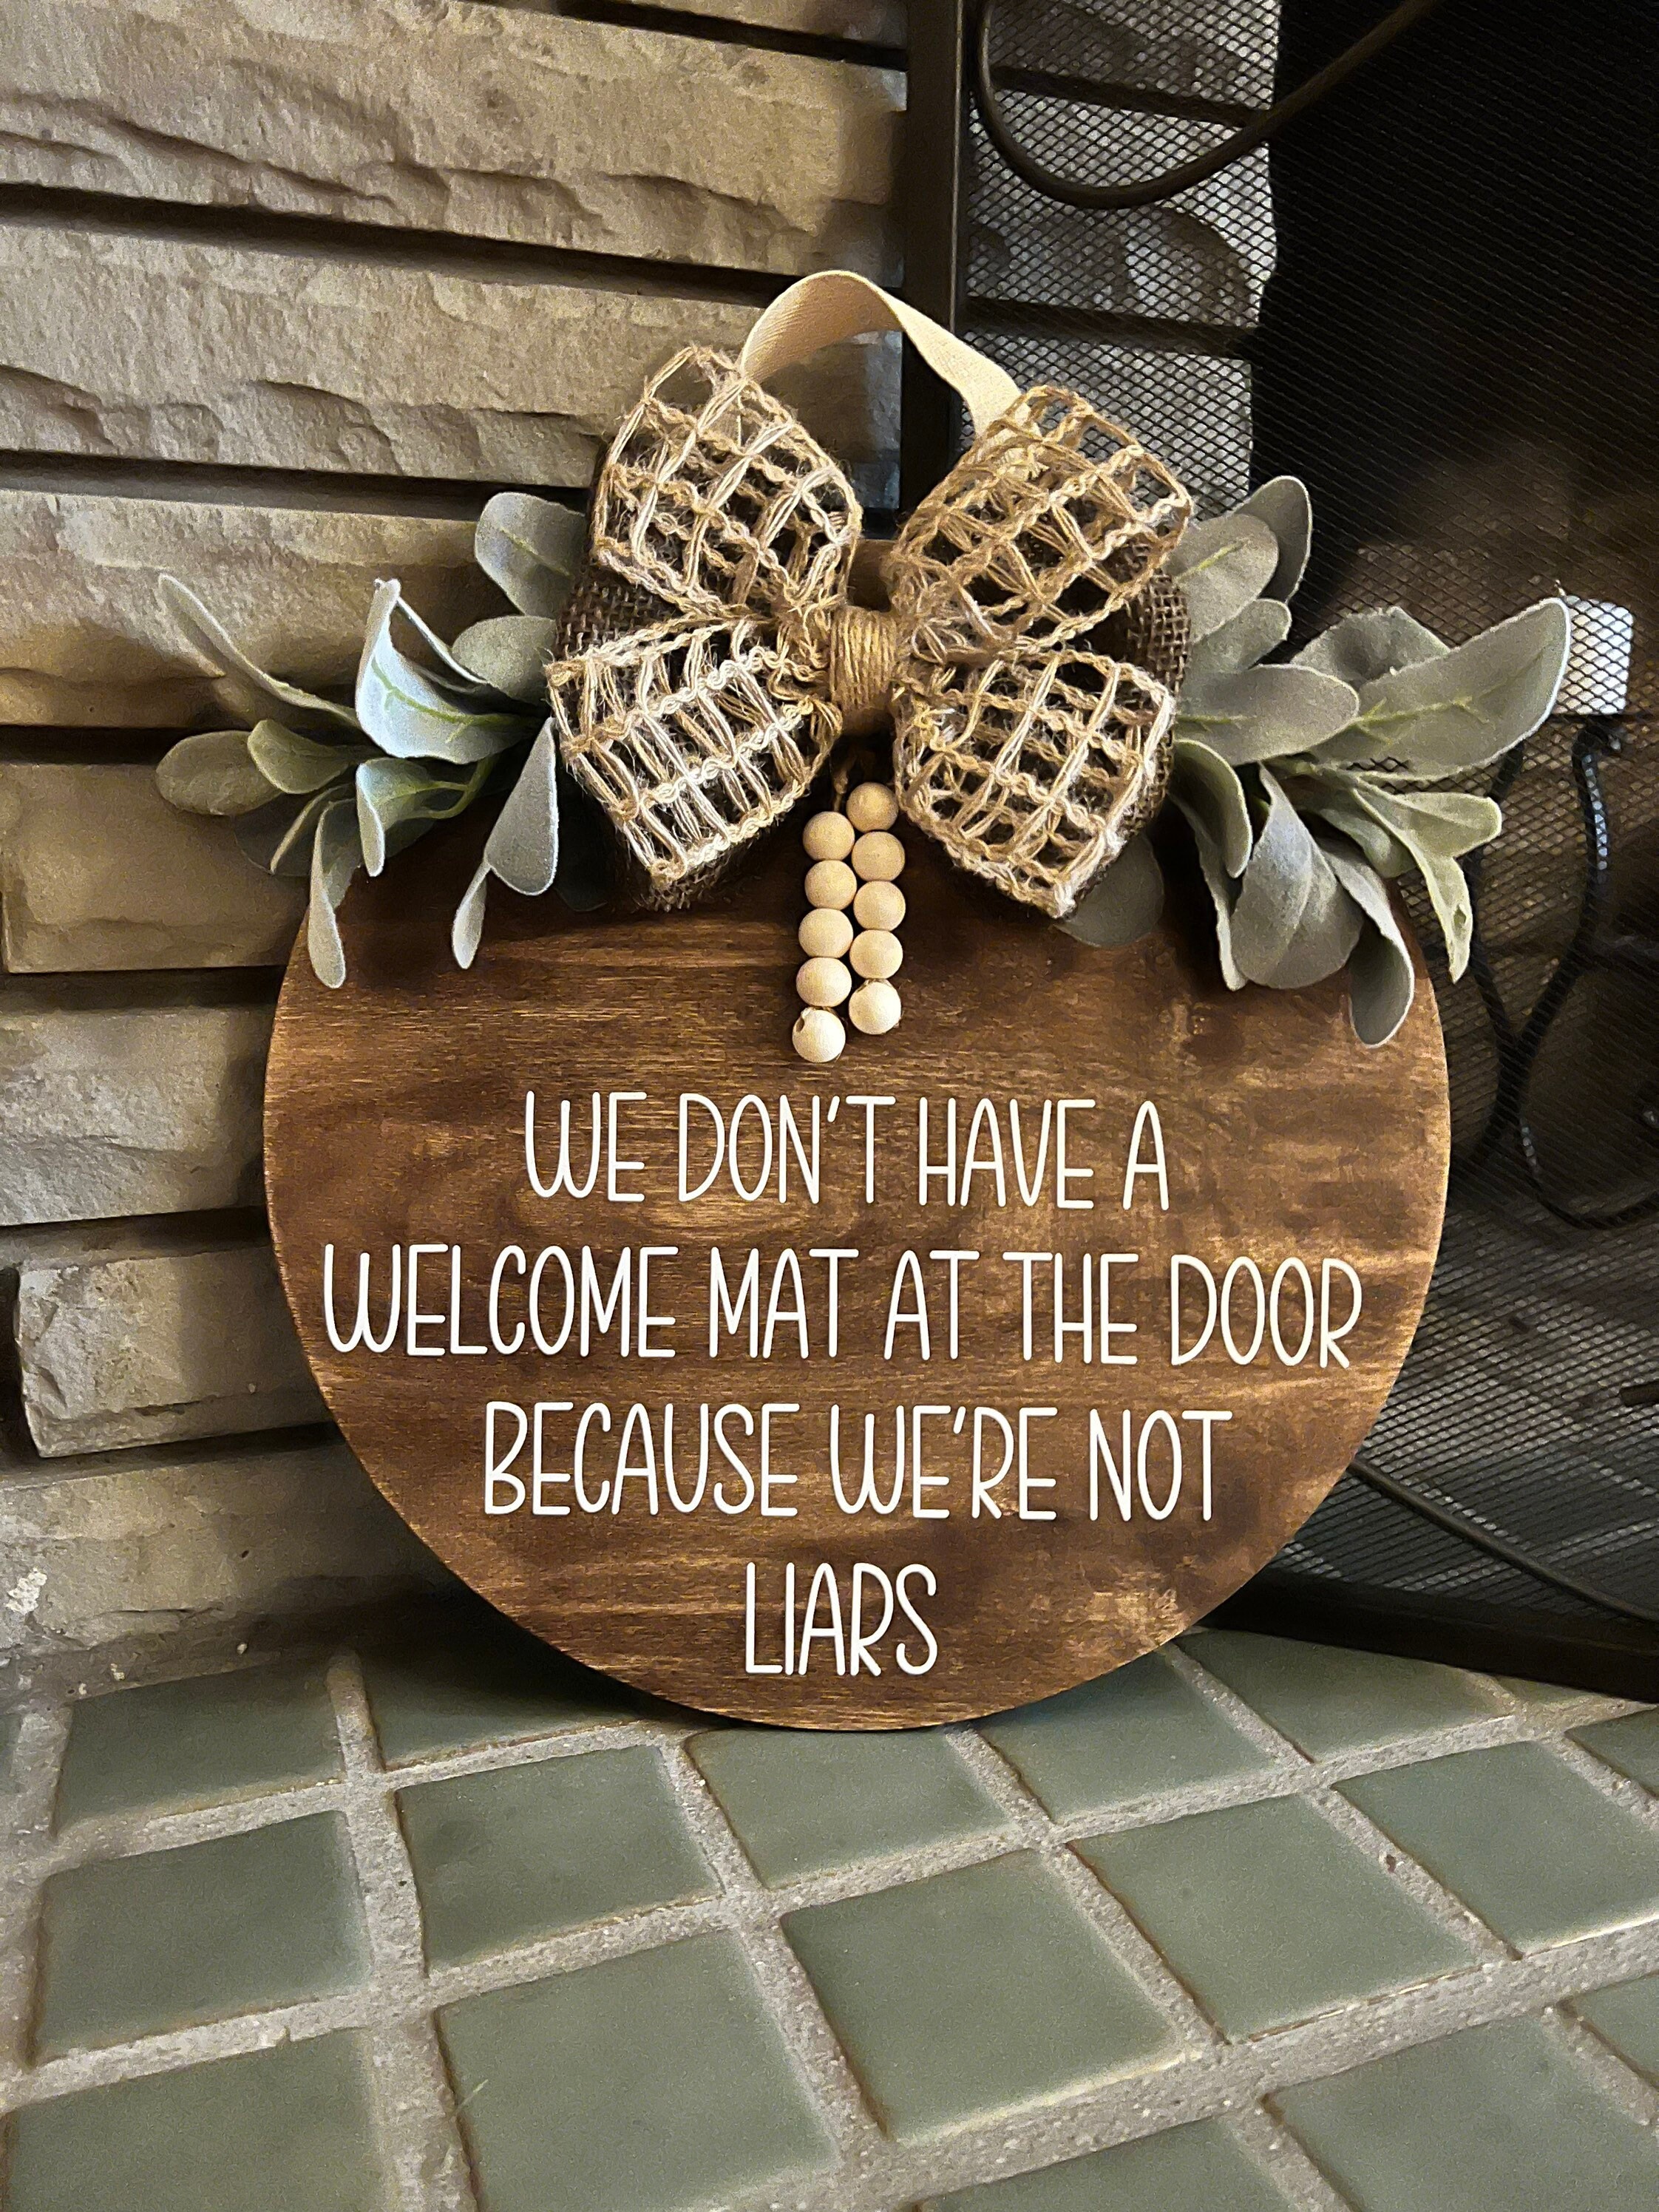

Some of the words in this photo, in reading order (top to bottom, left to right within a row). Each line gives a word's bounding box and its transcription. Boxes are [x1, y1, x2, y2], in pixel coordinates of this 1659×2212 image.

[524, 1090, 648, 1203] WE
[677, 1092, 897, 1205] DON'T
[918, 1096, 1096, 1210] HAVE
[1122, 1099, 1170, 1212] A
[323, 1243, 679, 1358] WELCOME
[708, 1246, 860, 1360] MAT
[883, 1249, 980, 1361] AT
[1002, 1251, 1139, 1365] THE
[1170, 1253, 1363, 1370] DOOR
[484, 1400, 801, 1517] BECAUSE
[830, 1403, 1059, 1521] WE'RE
[1089, 1408, 1234, 1522] NOT
[744, 1561, 938, 1677] LIARS
